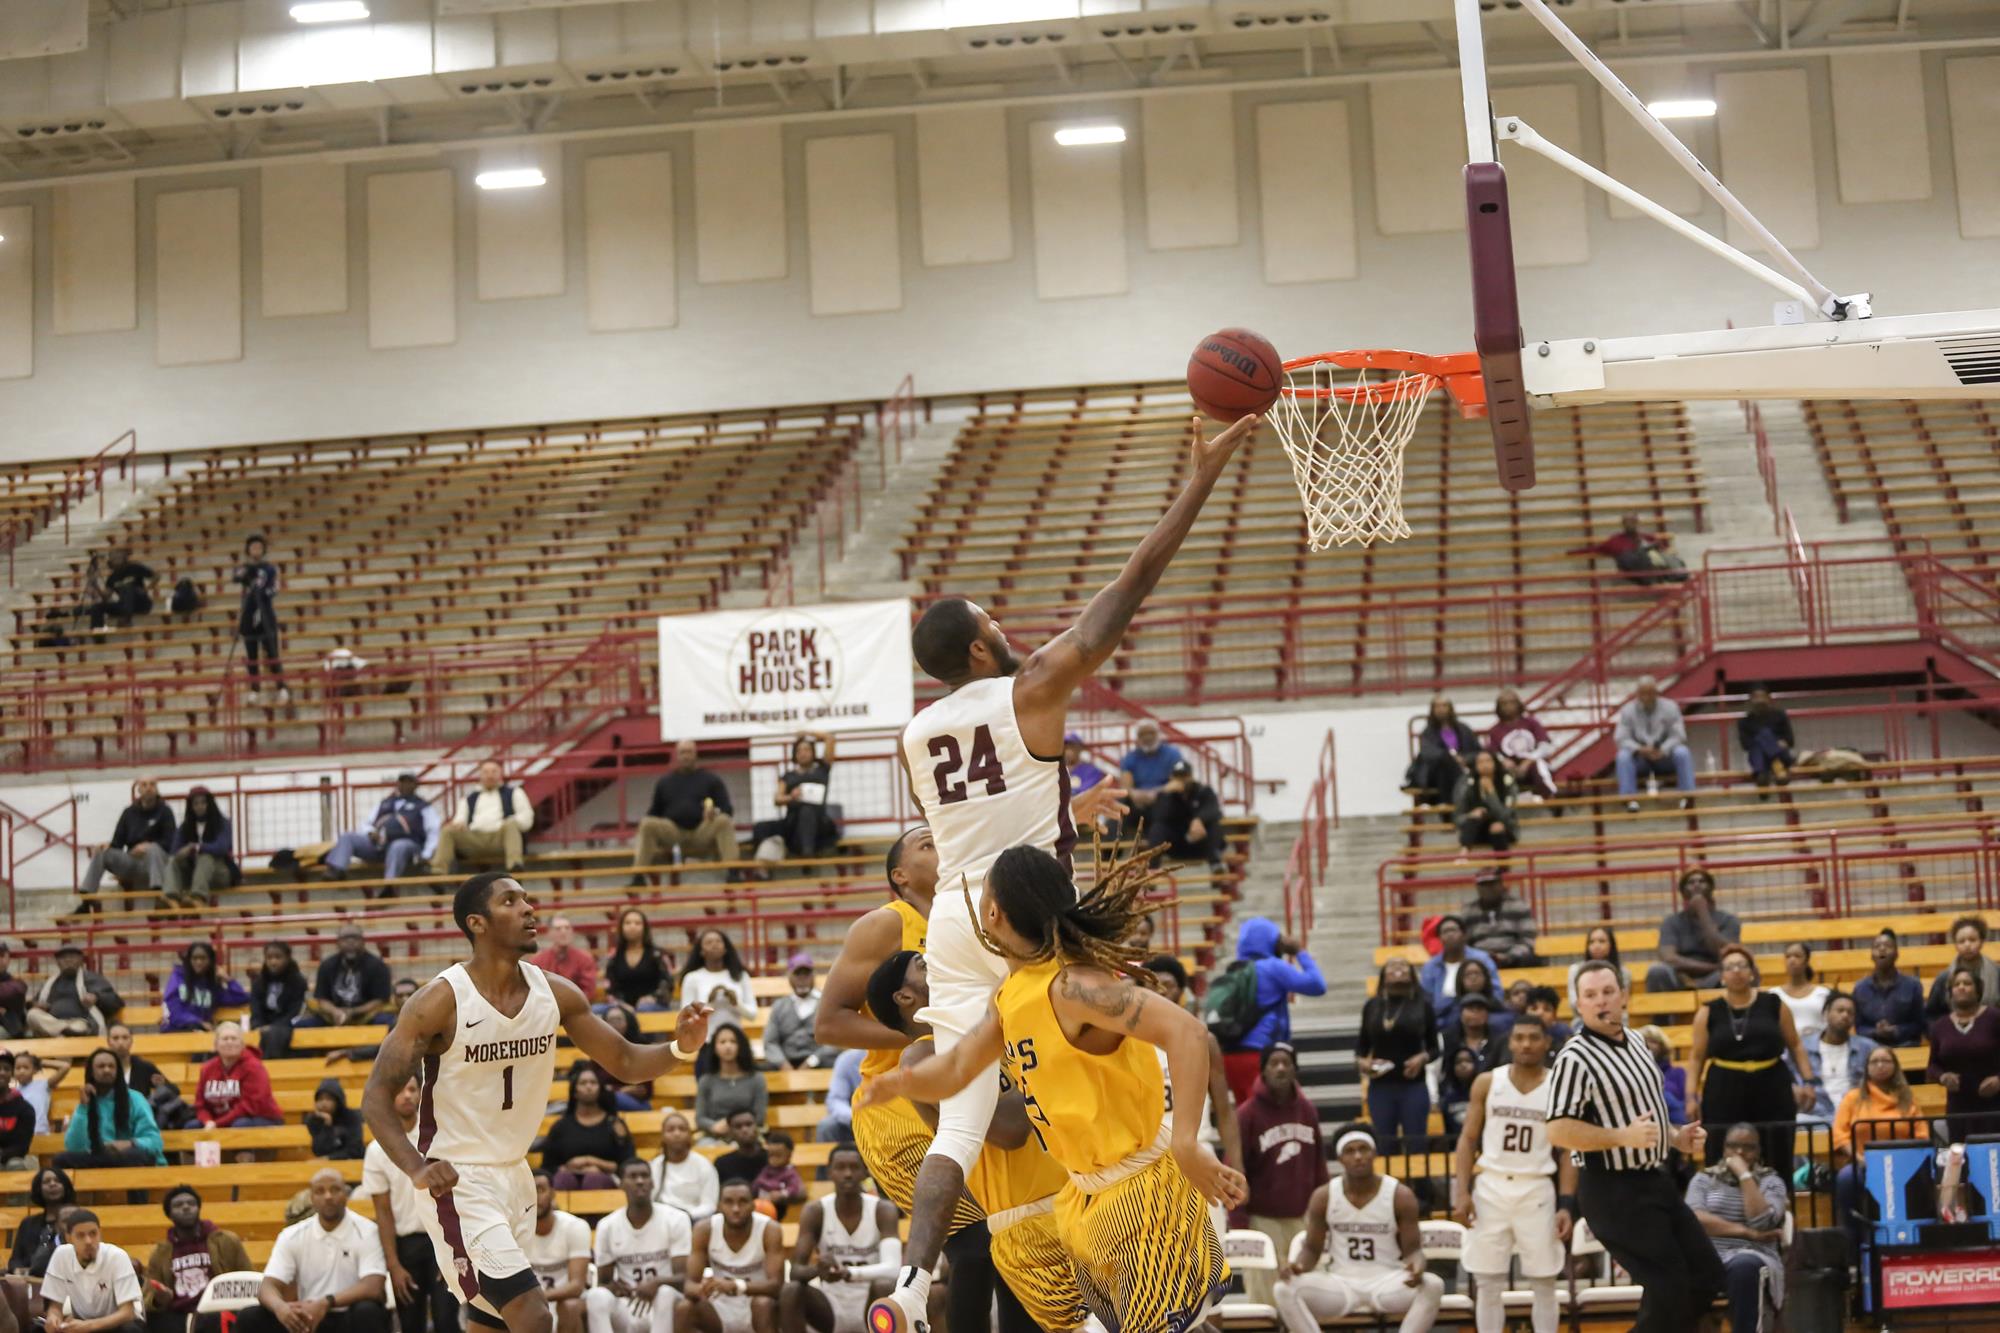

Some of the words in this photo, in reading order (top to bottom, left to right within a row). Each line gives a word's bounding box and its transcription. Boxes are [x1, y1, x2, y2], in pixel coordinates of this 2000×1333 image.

[1203, 342, 1259, 378] Wilson
[749, 628, 817, 661] PACK
[762, 654, 795, 667] THE
[739, 659, 833, 694] HOUSE!
[703, 708, 799, 725] MOREHOUSE
[804, 702, 870, 720] COLLEGE
[927, 723, 1007, 805] 24
[501, 1065, 514, 1111] 1
[1503, 1123, 1533, 1153] 20
[1347, 1236, 1375, 1260] 23
